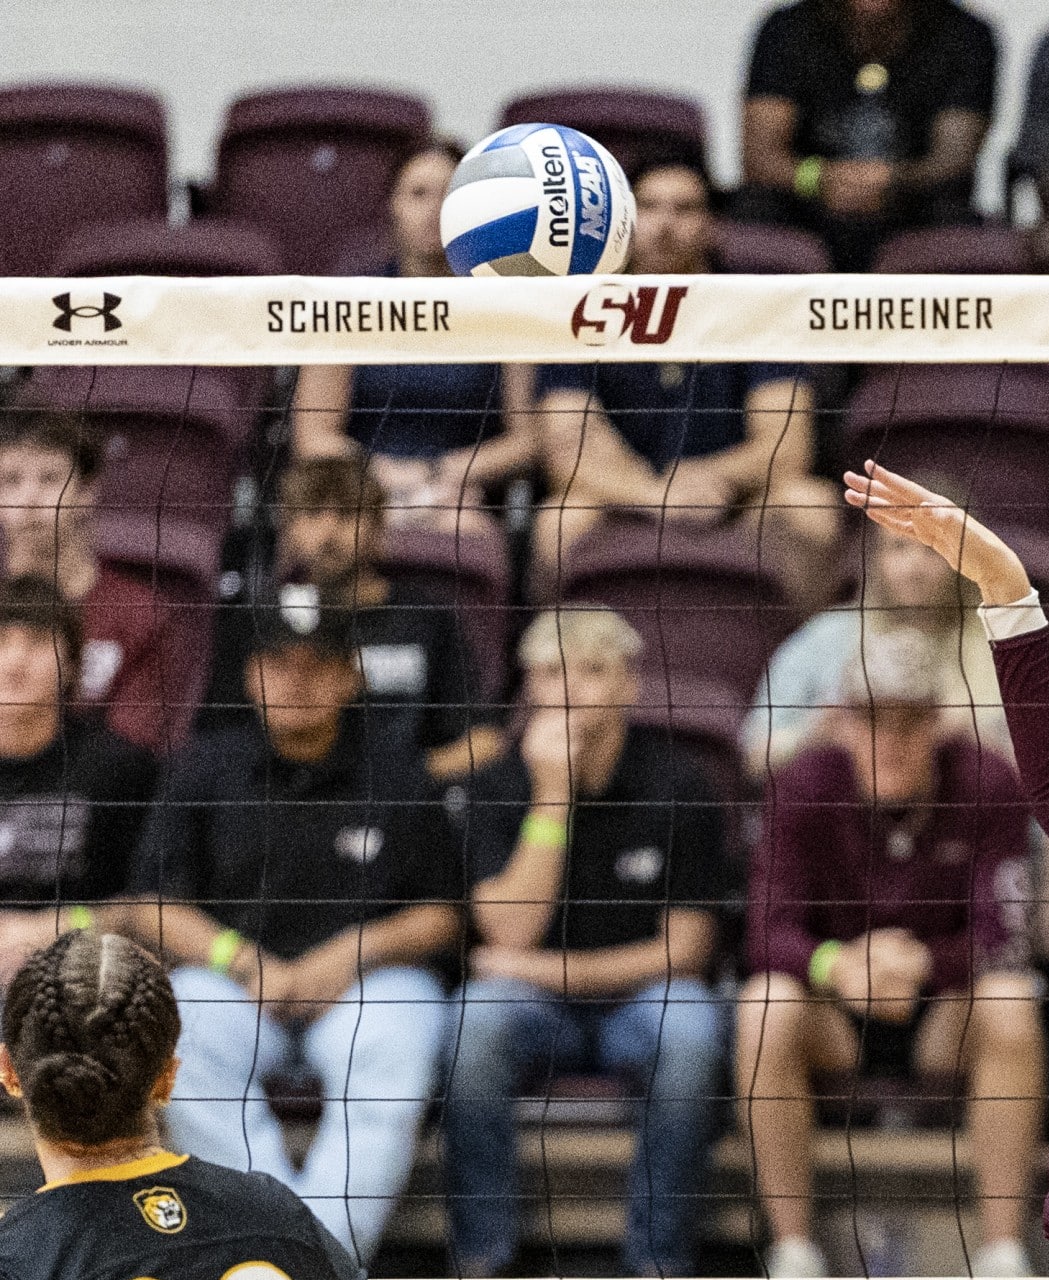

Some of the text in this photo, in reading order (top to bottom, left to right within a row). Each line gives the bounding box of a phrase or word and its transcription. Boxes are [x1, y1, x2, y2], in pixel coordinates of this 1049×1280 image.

[542, 146, 569, 247] molten
[573, 155, 606, 241] NCAA
[268, 300, 450, 332] SCHREINER
[571, 283, 689, 346] SU
[809, 298, 993, 330] SCHREINER
